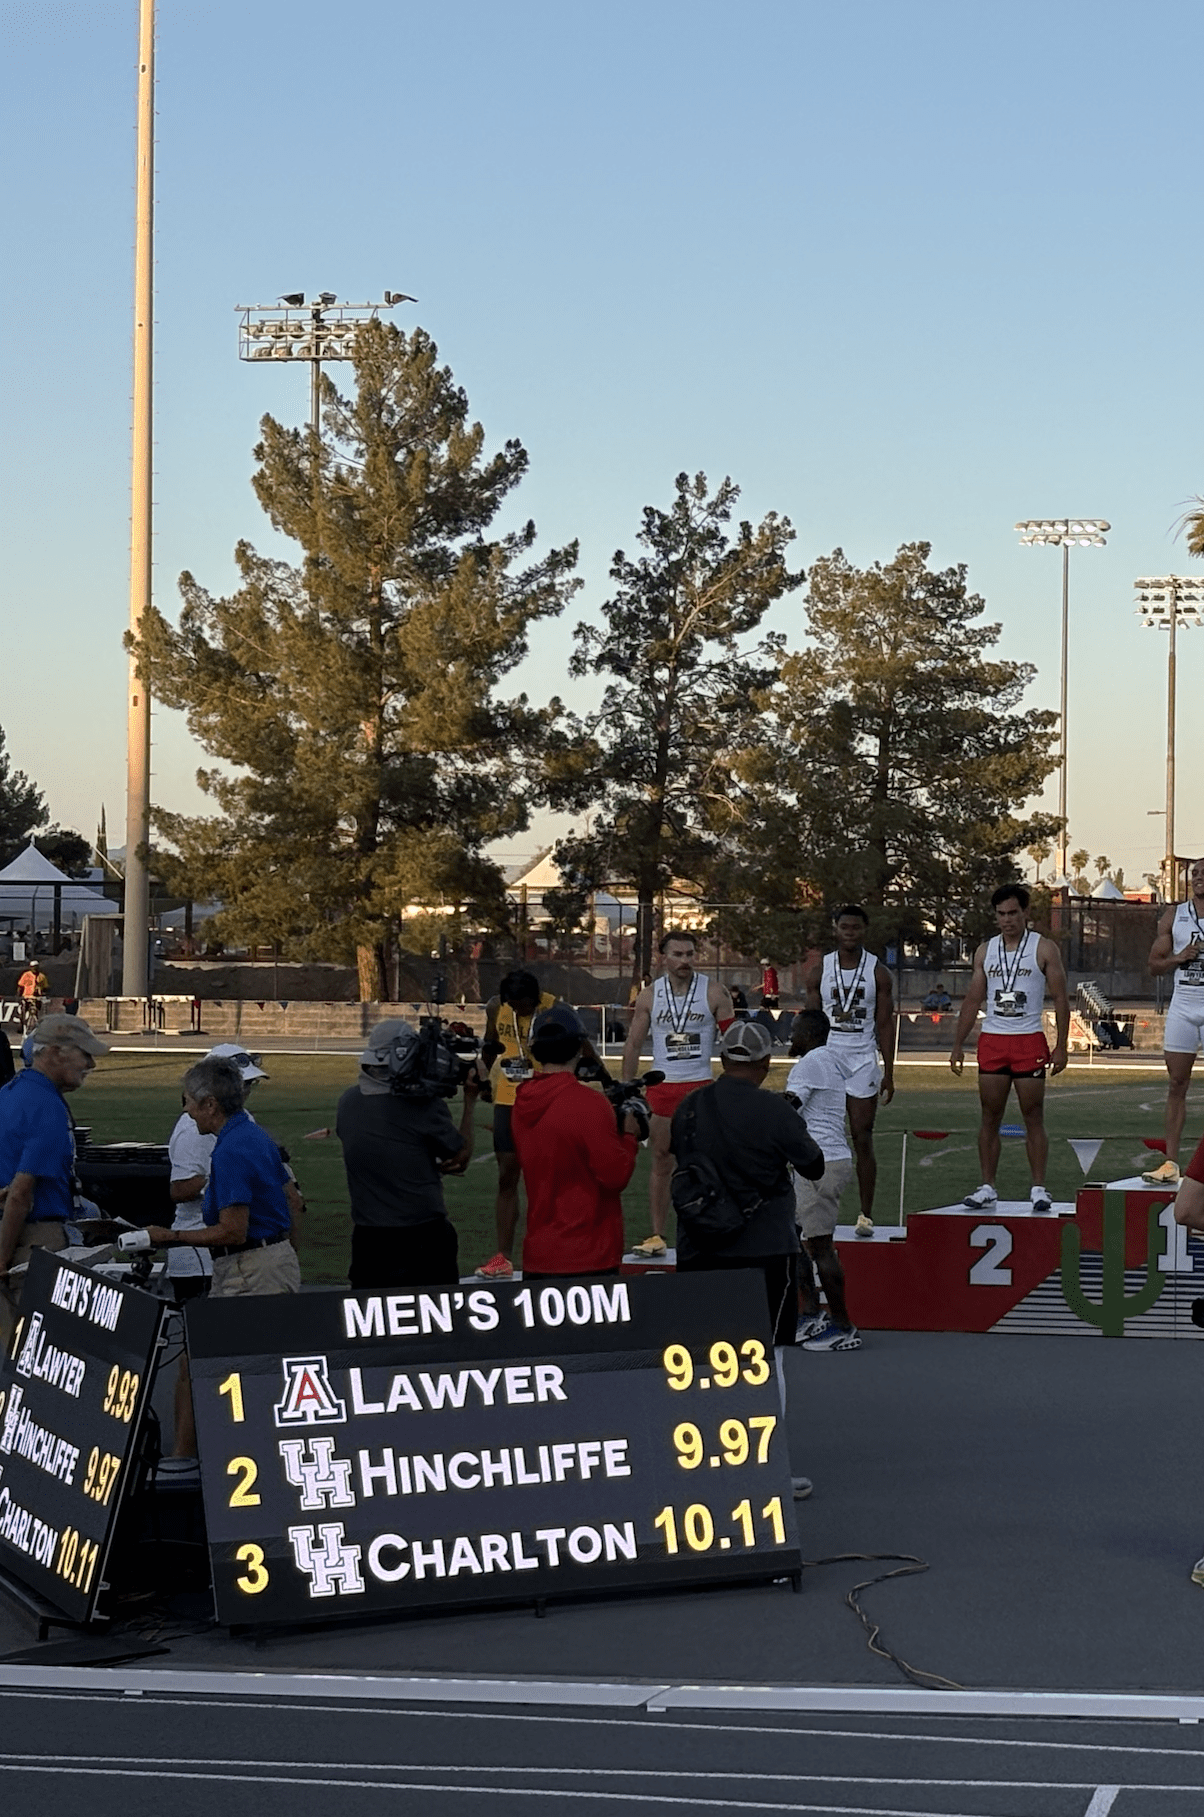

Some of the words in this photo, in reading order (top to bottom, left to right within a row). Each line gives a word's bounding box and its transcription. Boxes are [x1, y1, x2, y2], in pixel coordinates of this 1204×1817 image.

[969, 1224, 1013, 1286] 2
[1157, 1201, 1194, 1272] 1
[51, 1266, 92, 1317] MEN'S
[88, 1283, 124, 1332] 100M
[343, 1290, 500, 1338] MEN'S
[513, 1283, 632, 1328] 100M
[10, 1317, 25, 1361] 1
[33, 1330, 86, 1398] LAWYER
[103, 1364, 139, 1423] 9.93
[218, 1372, 245, 1423] 1
[273, 1355, 348, 1428] A
[350, 1364, 568, 1415] LAWYER
[663, 1339, 770, 1391] 9.93
[12, 1406, 80, 1486] HINCHLIFFE
[83, 1446, 121, 1506] 9.97
[226, 1456, 262, 1508] 2
[358, 1438, 632, 1498] HINCHLIFFE
[673, 1415, 777, 1469] 9.97
[56, 1525, 99, 1594] 10.11
[235, 1543, 270, 1595] 3
[368, 1521, 638, 1582] CHARLTON
[655, 1496, 786, 1554] 10.11
